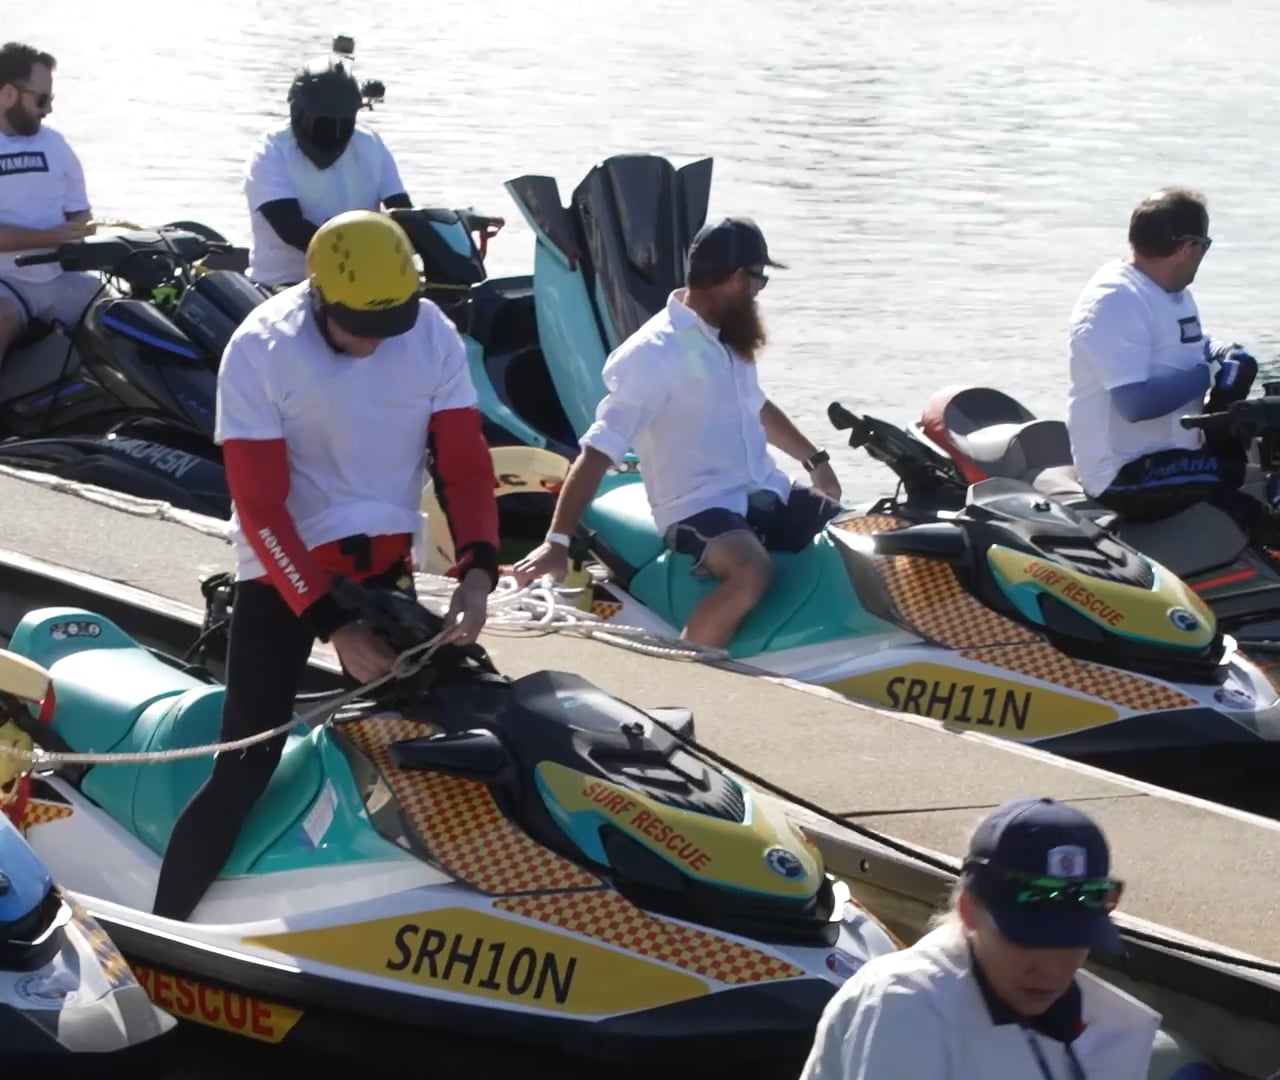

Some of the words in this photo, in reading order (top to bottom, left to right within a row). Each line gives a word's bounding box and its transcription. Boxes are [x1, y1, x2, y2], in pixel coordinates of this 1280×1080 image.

[258, 527, 308, 594] RONSTAN
[1024, 562, 1065, 586] SURF
[1062, 582, 1125, 626] RESCUE
[885, 676, 1032, 730] SRH11N
[582, 782, 636, 815] SURF
[630, 810, 712, 871] RESCUE
[386, 924, 577, 1005] SRH10N
